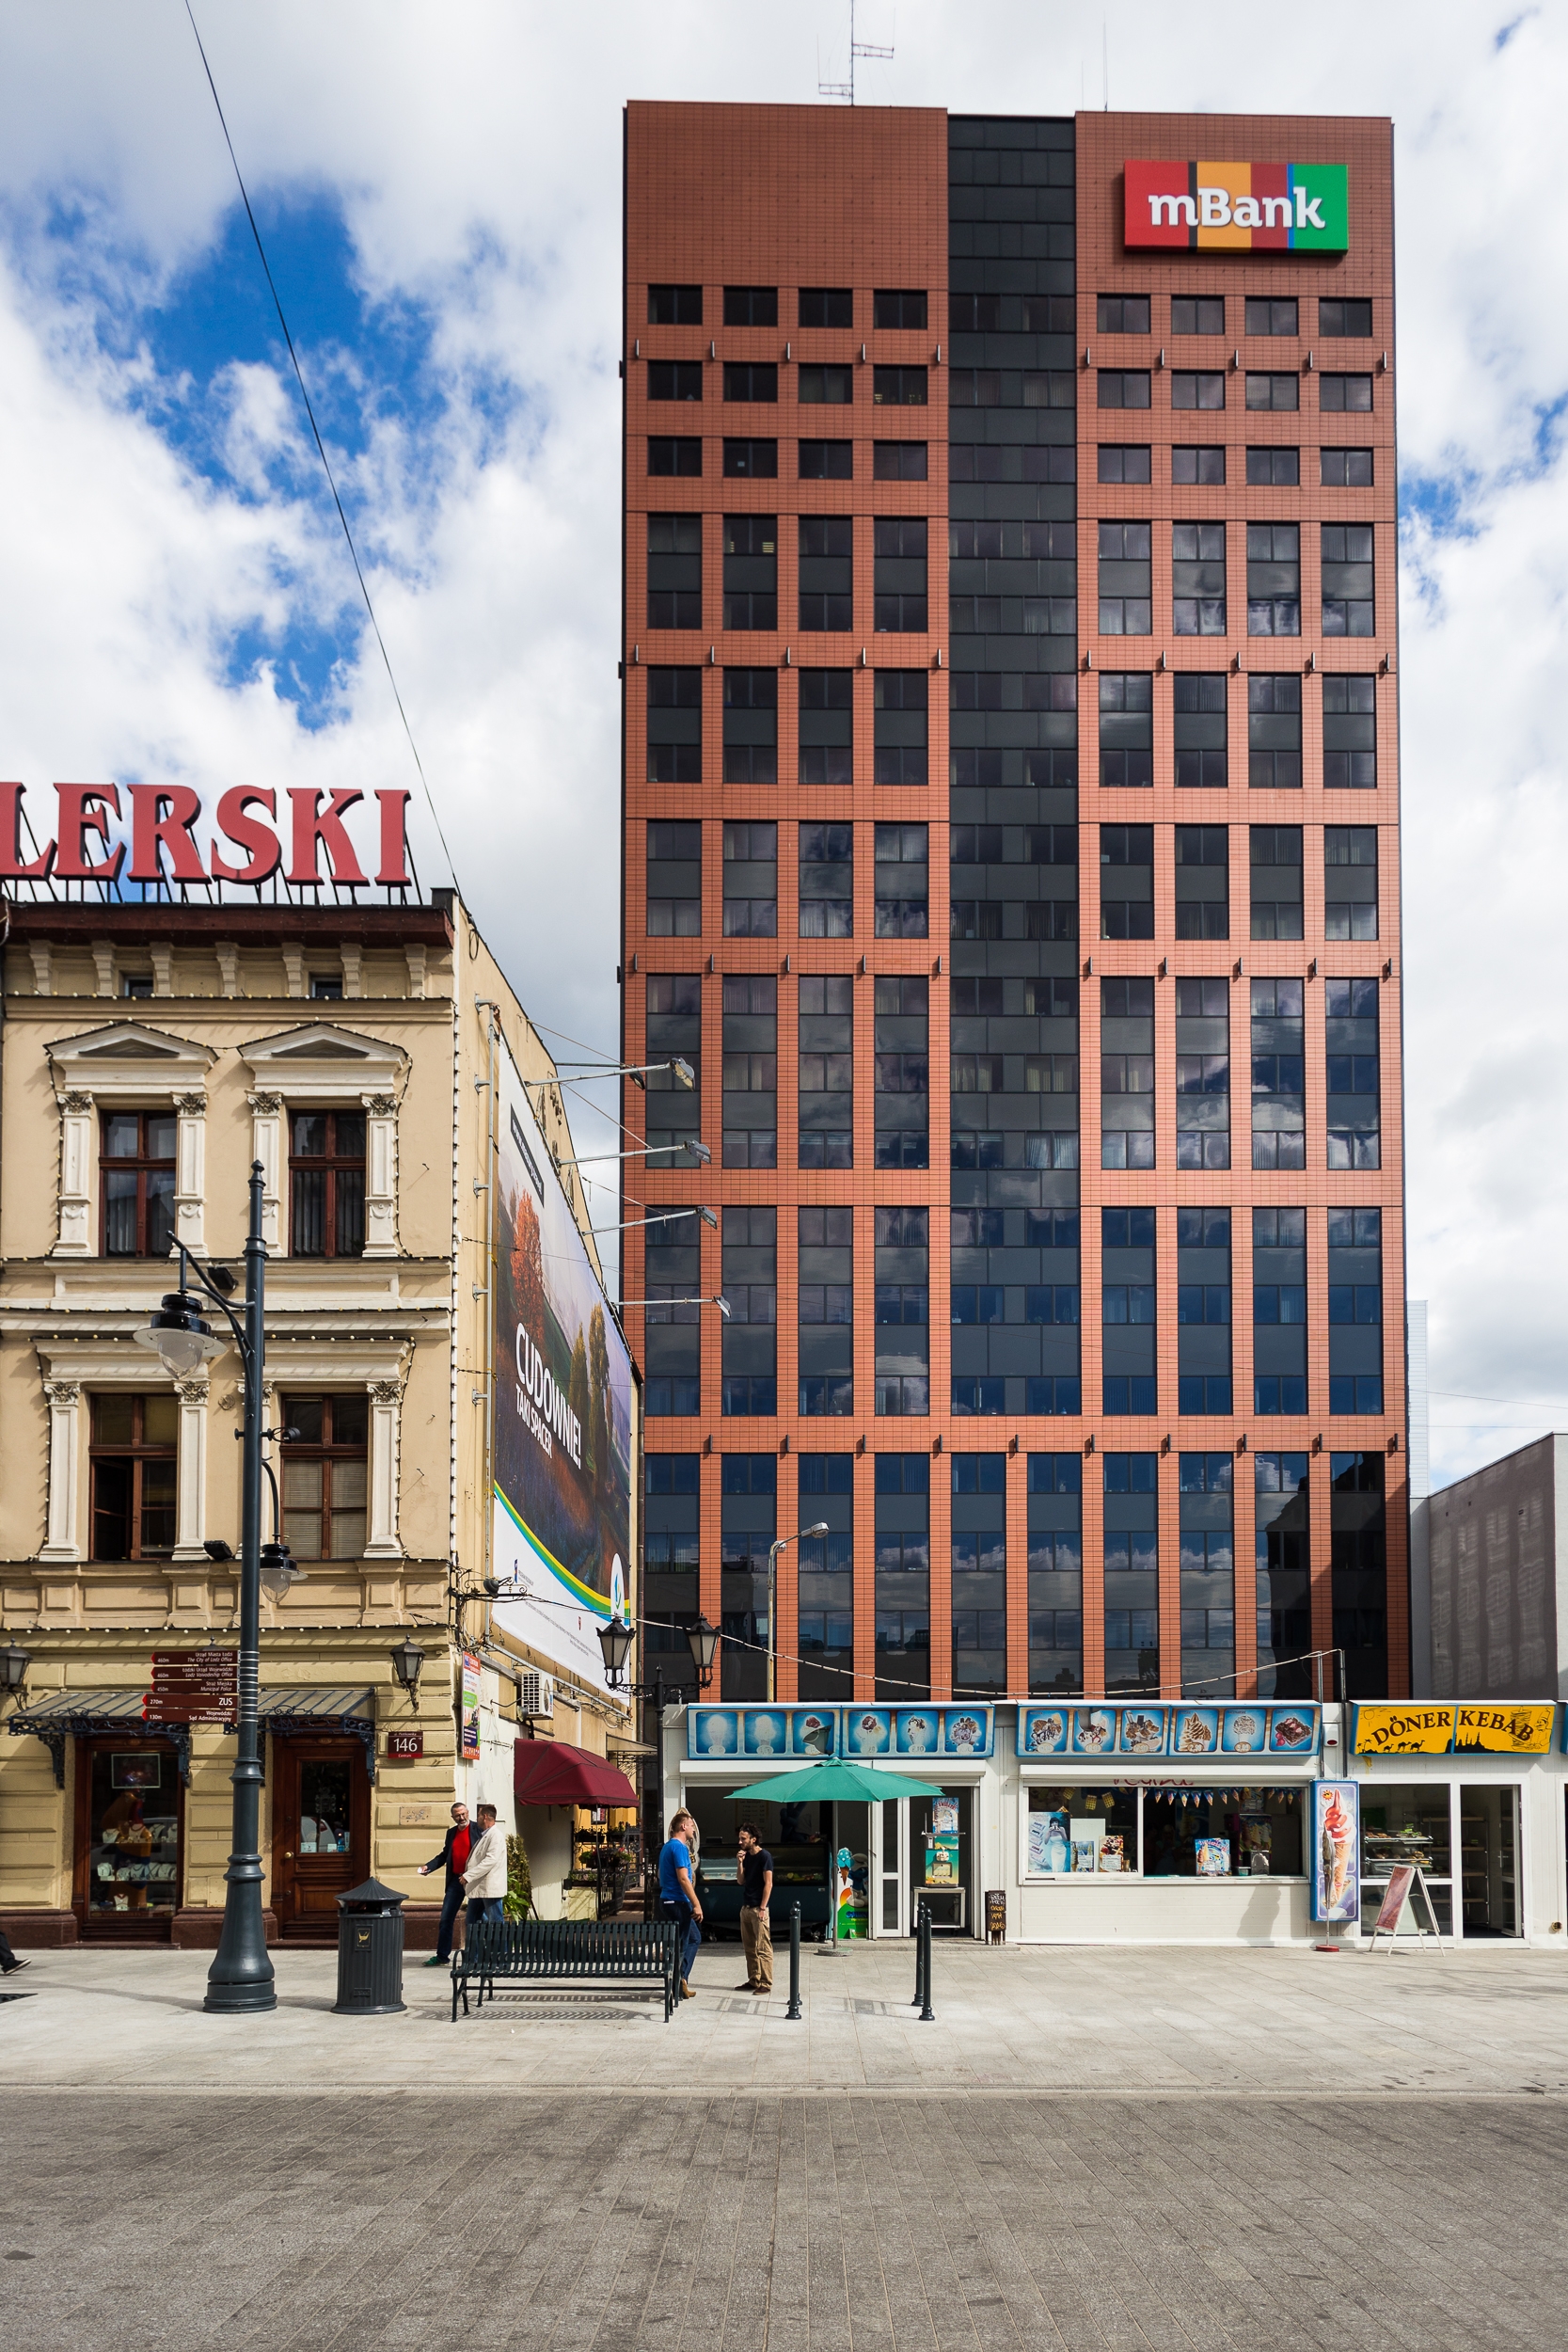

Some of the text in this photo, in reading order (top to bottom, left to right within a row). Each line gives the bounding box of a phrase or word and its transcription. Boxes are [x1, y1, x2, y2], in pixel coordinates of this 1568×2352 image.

[1148, 186, 1326, 229] mBank
[515, 1322, 581, 1470] CUDOWNIE!
[515, 1382, 553, 1459] TAKI SPACER
[218, 1697, 233, 1706] ZUS
[393, 1738, 418, 1752] 146
[1370, 1709, 1534, 1746] DÖNER KEBAB
